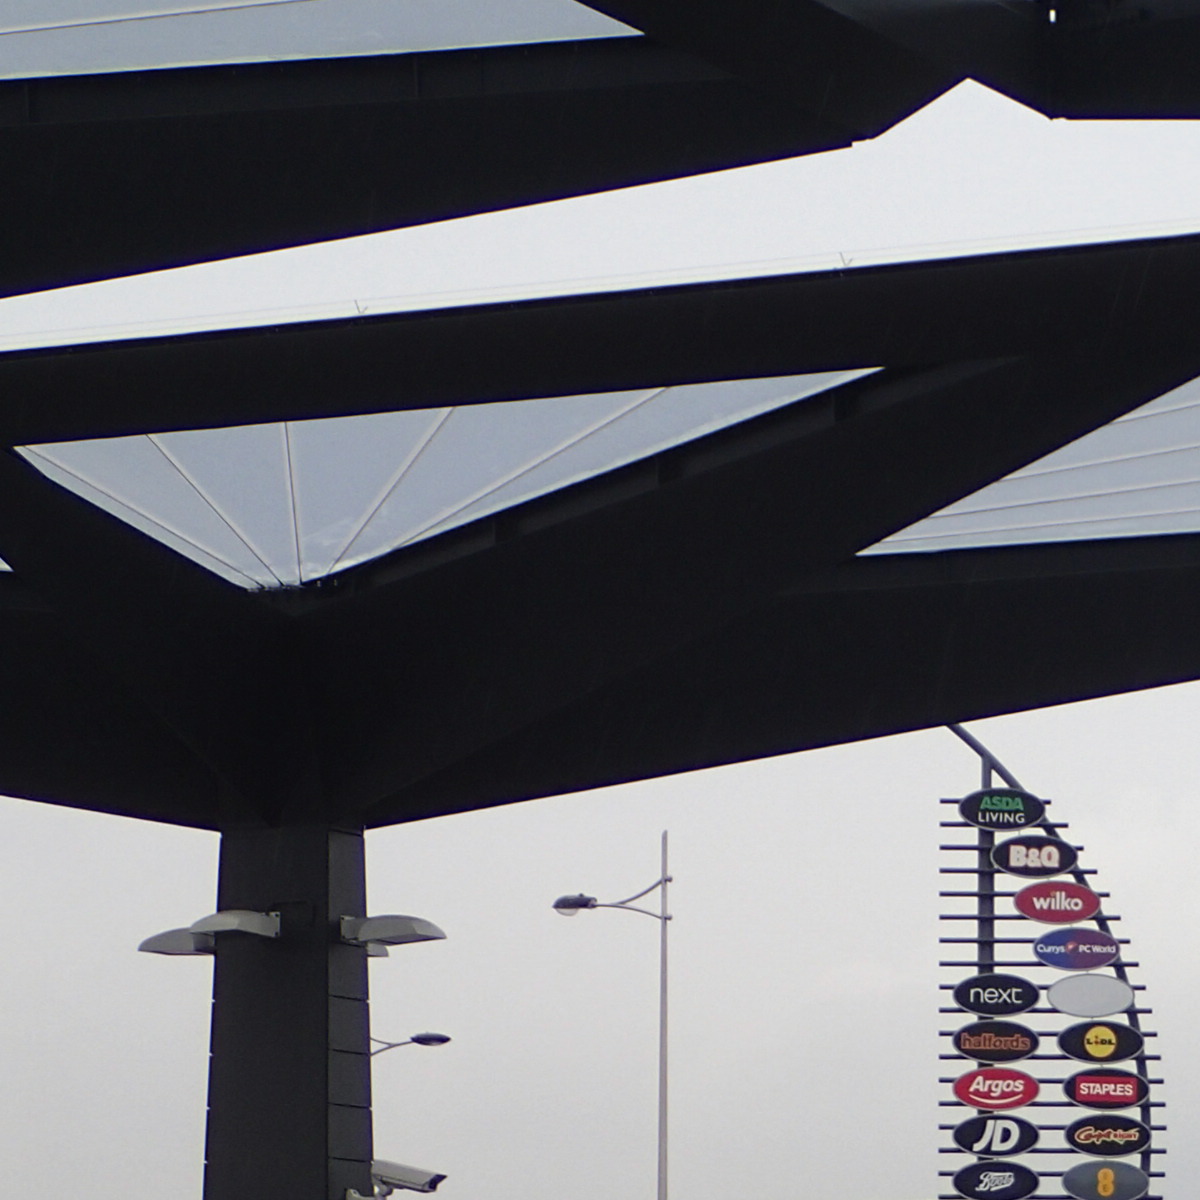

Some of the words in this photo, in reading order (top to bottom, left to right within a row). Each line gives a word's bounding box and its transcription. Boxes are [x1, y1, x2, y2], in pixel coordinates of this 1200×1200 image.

[979, 796, 1024, 811] ASDA
[978, 812, 1025, 824] LIVING
[1008, 844, 1060, 869] B&Q
[1032, 891, 1083, 912] wilko
[1036, 943, 1065, 954] Currys
[969, 986, 1023, 1004] next
[961, 1033, 1031, 1050] halfords
[969, 1075, 1025, 1098] Argos
[1079, 1083, 1133, 1096] STAPLES
[972, 1119, 1020, 1152] JD
[975, 1171, 1016, 1192] Boots
